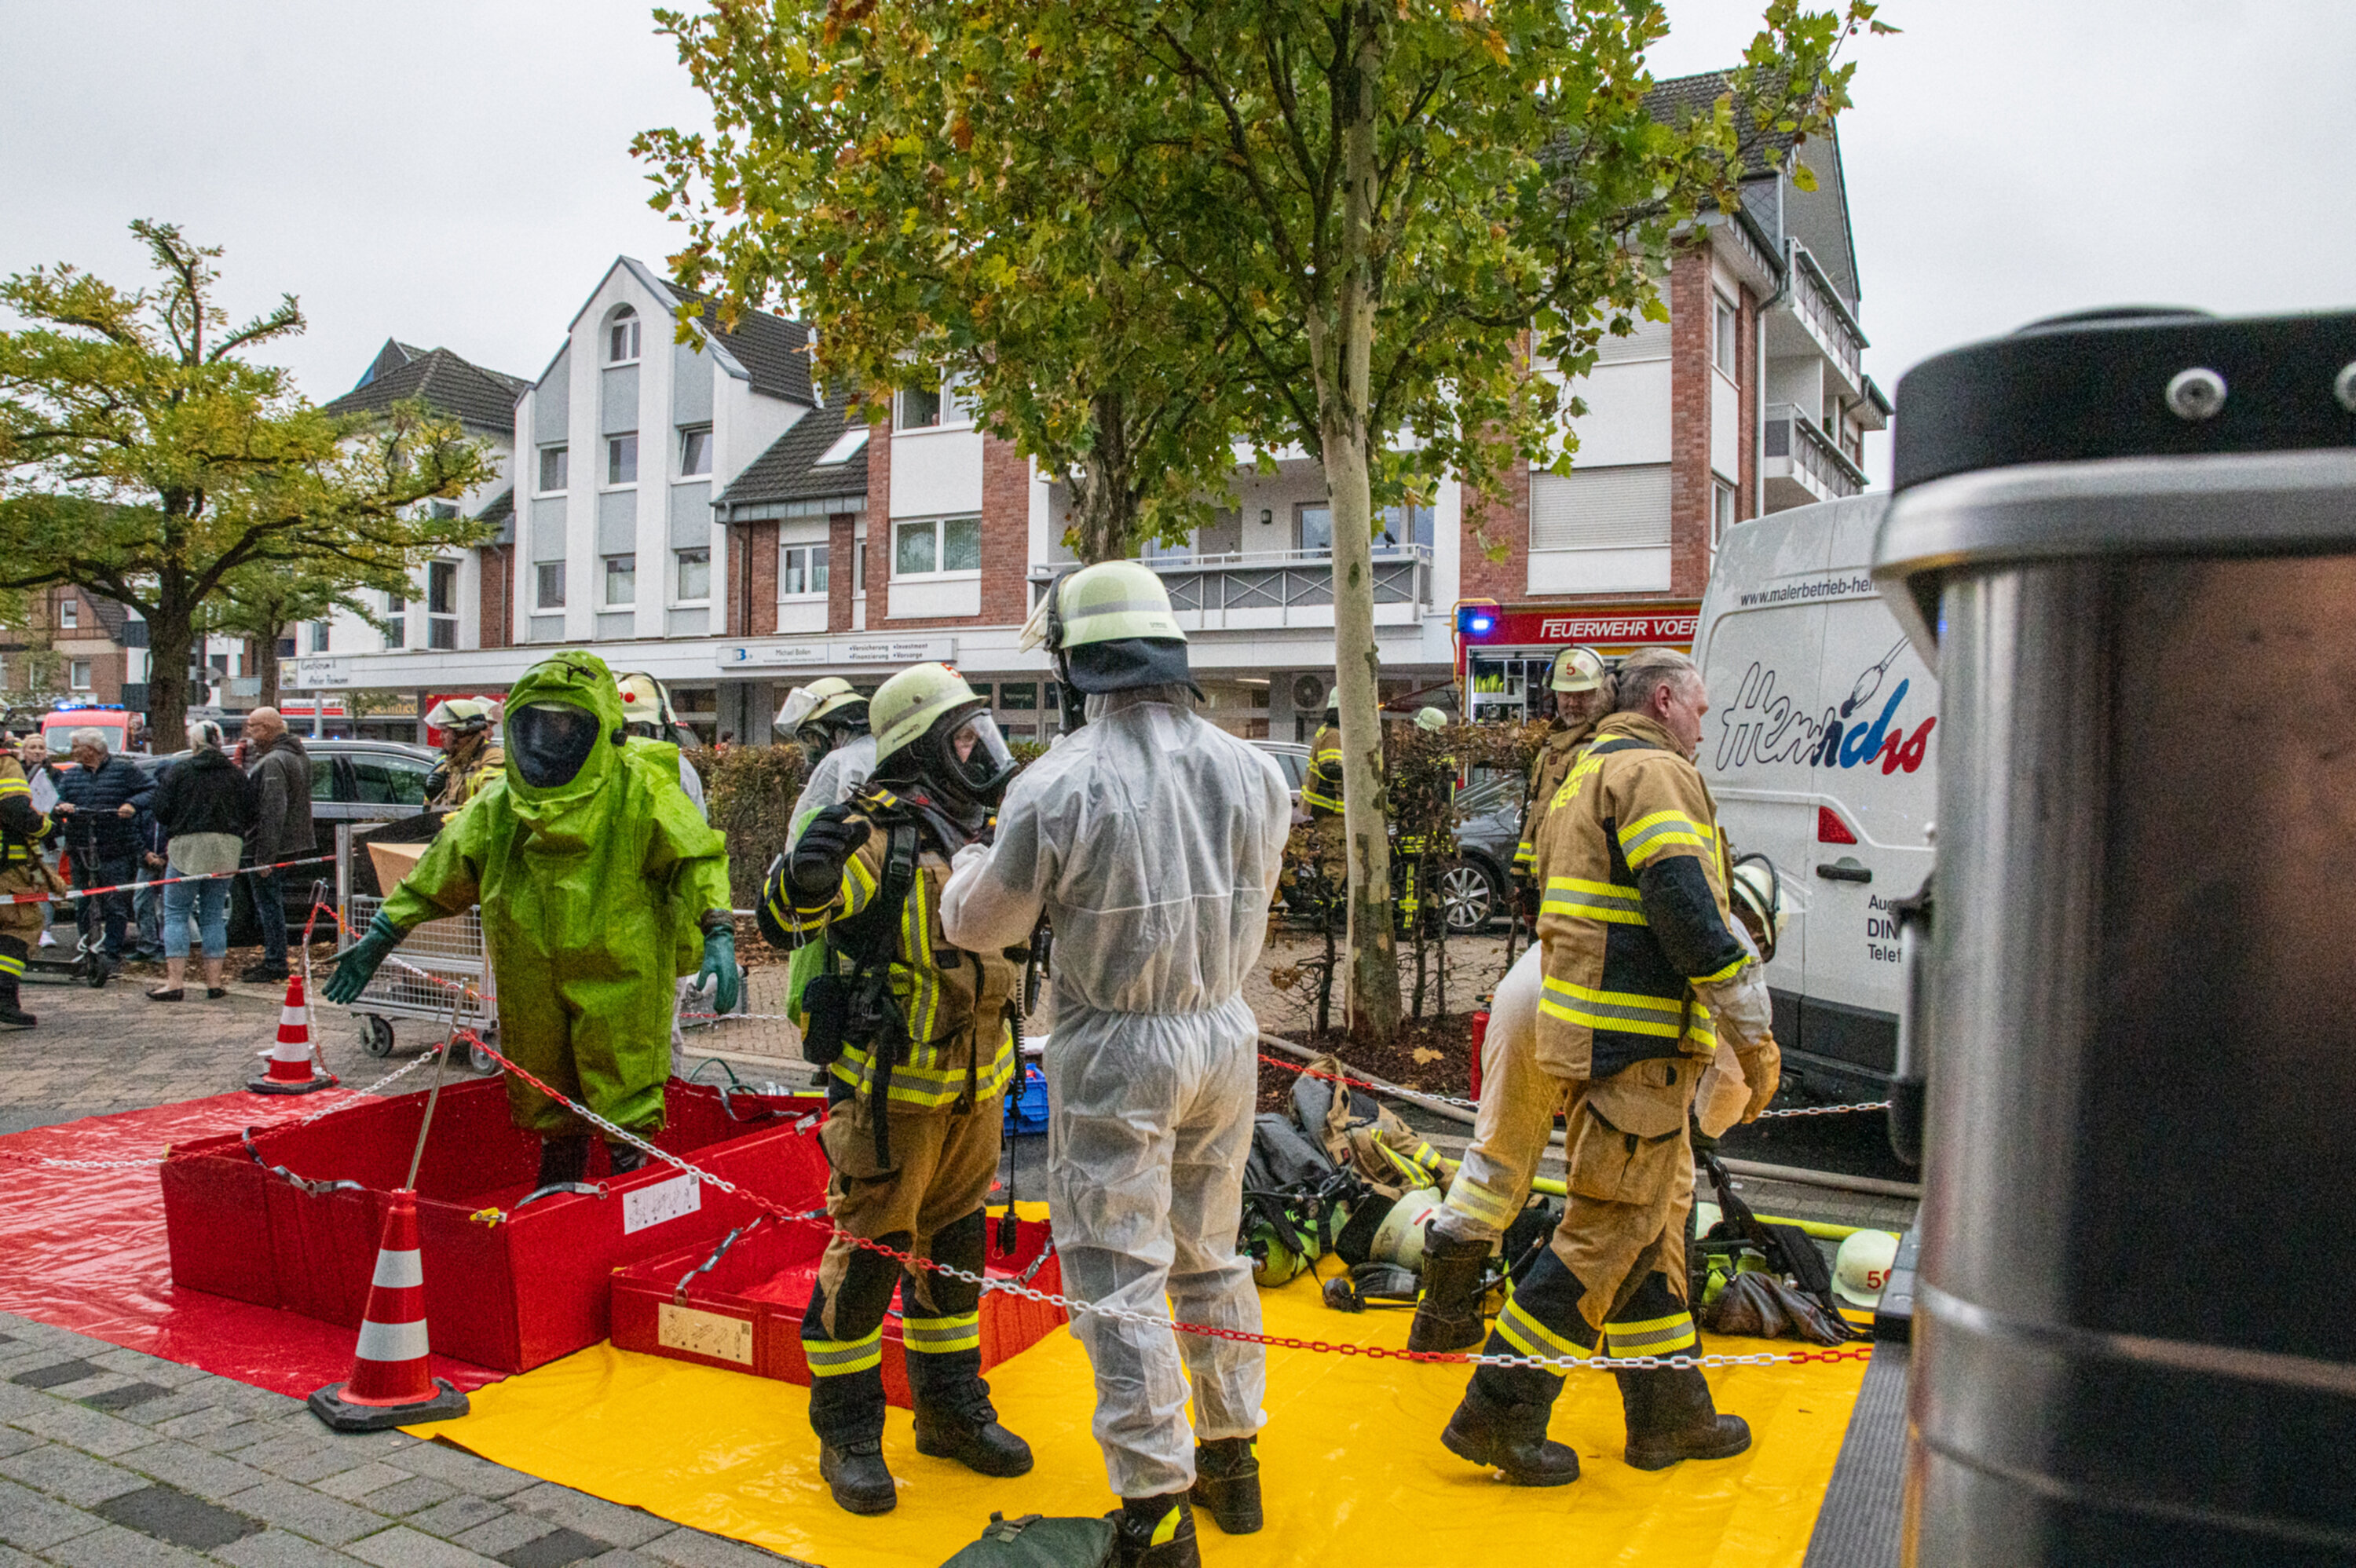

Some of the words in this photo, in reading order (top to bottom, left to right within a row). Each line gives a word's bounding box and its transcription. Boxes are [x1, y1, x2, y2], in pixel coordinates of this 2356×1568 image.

[1540, 619, 1648, 638] FEUERWEHR
[1565, 662, 1576, 676] 5
[1867, 1270, 1882, 1290] 5
